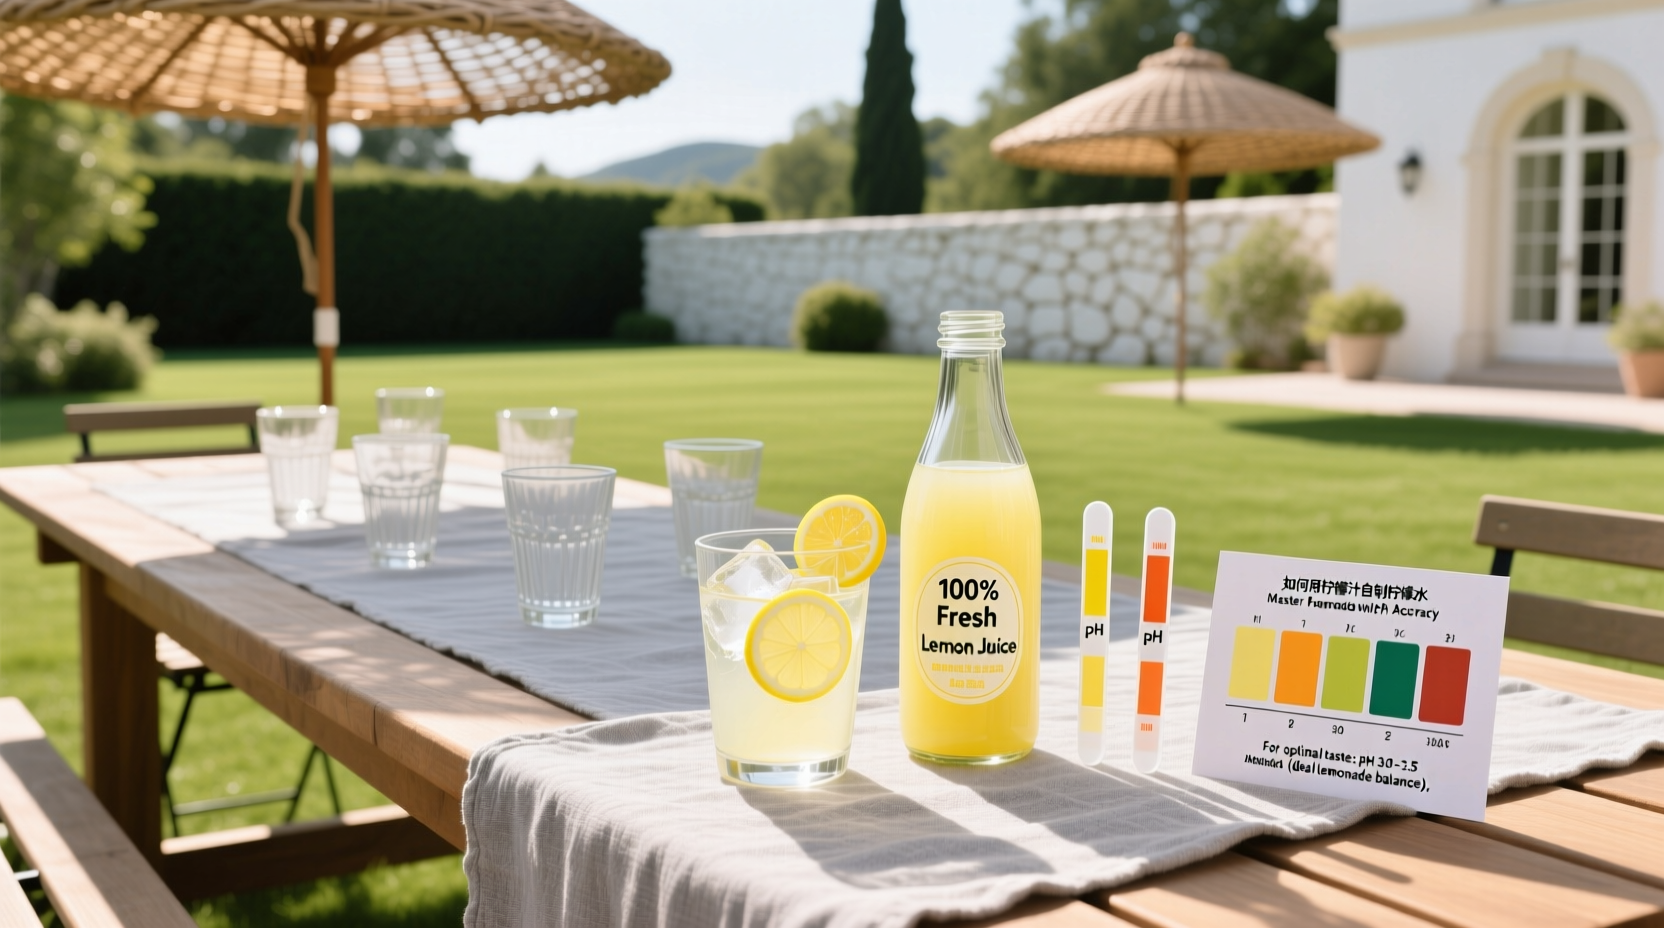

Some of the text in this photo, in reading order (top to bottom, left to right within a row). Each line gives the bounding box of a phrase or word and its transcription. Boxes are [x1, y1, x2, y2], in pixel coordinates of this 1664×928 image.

[938, 578, 999, 601] 100%
[937, 605, 997, 628] Fresh
[1085, 623, 1104, 639] pH
[1143, 630, 1163, 646] pH
[921, 633, 1017, 655] Lemon Juice
[1288, 719, 1295, 729] 2
[1384, 731, 1392, 741] 2
[1263, 740, 1281, 755] For
[1324, 751, 1356, 764] taste:
[1317, 762, 1373, 782] lemonade
